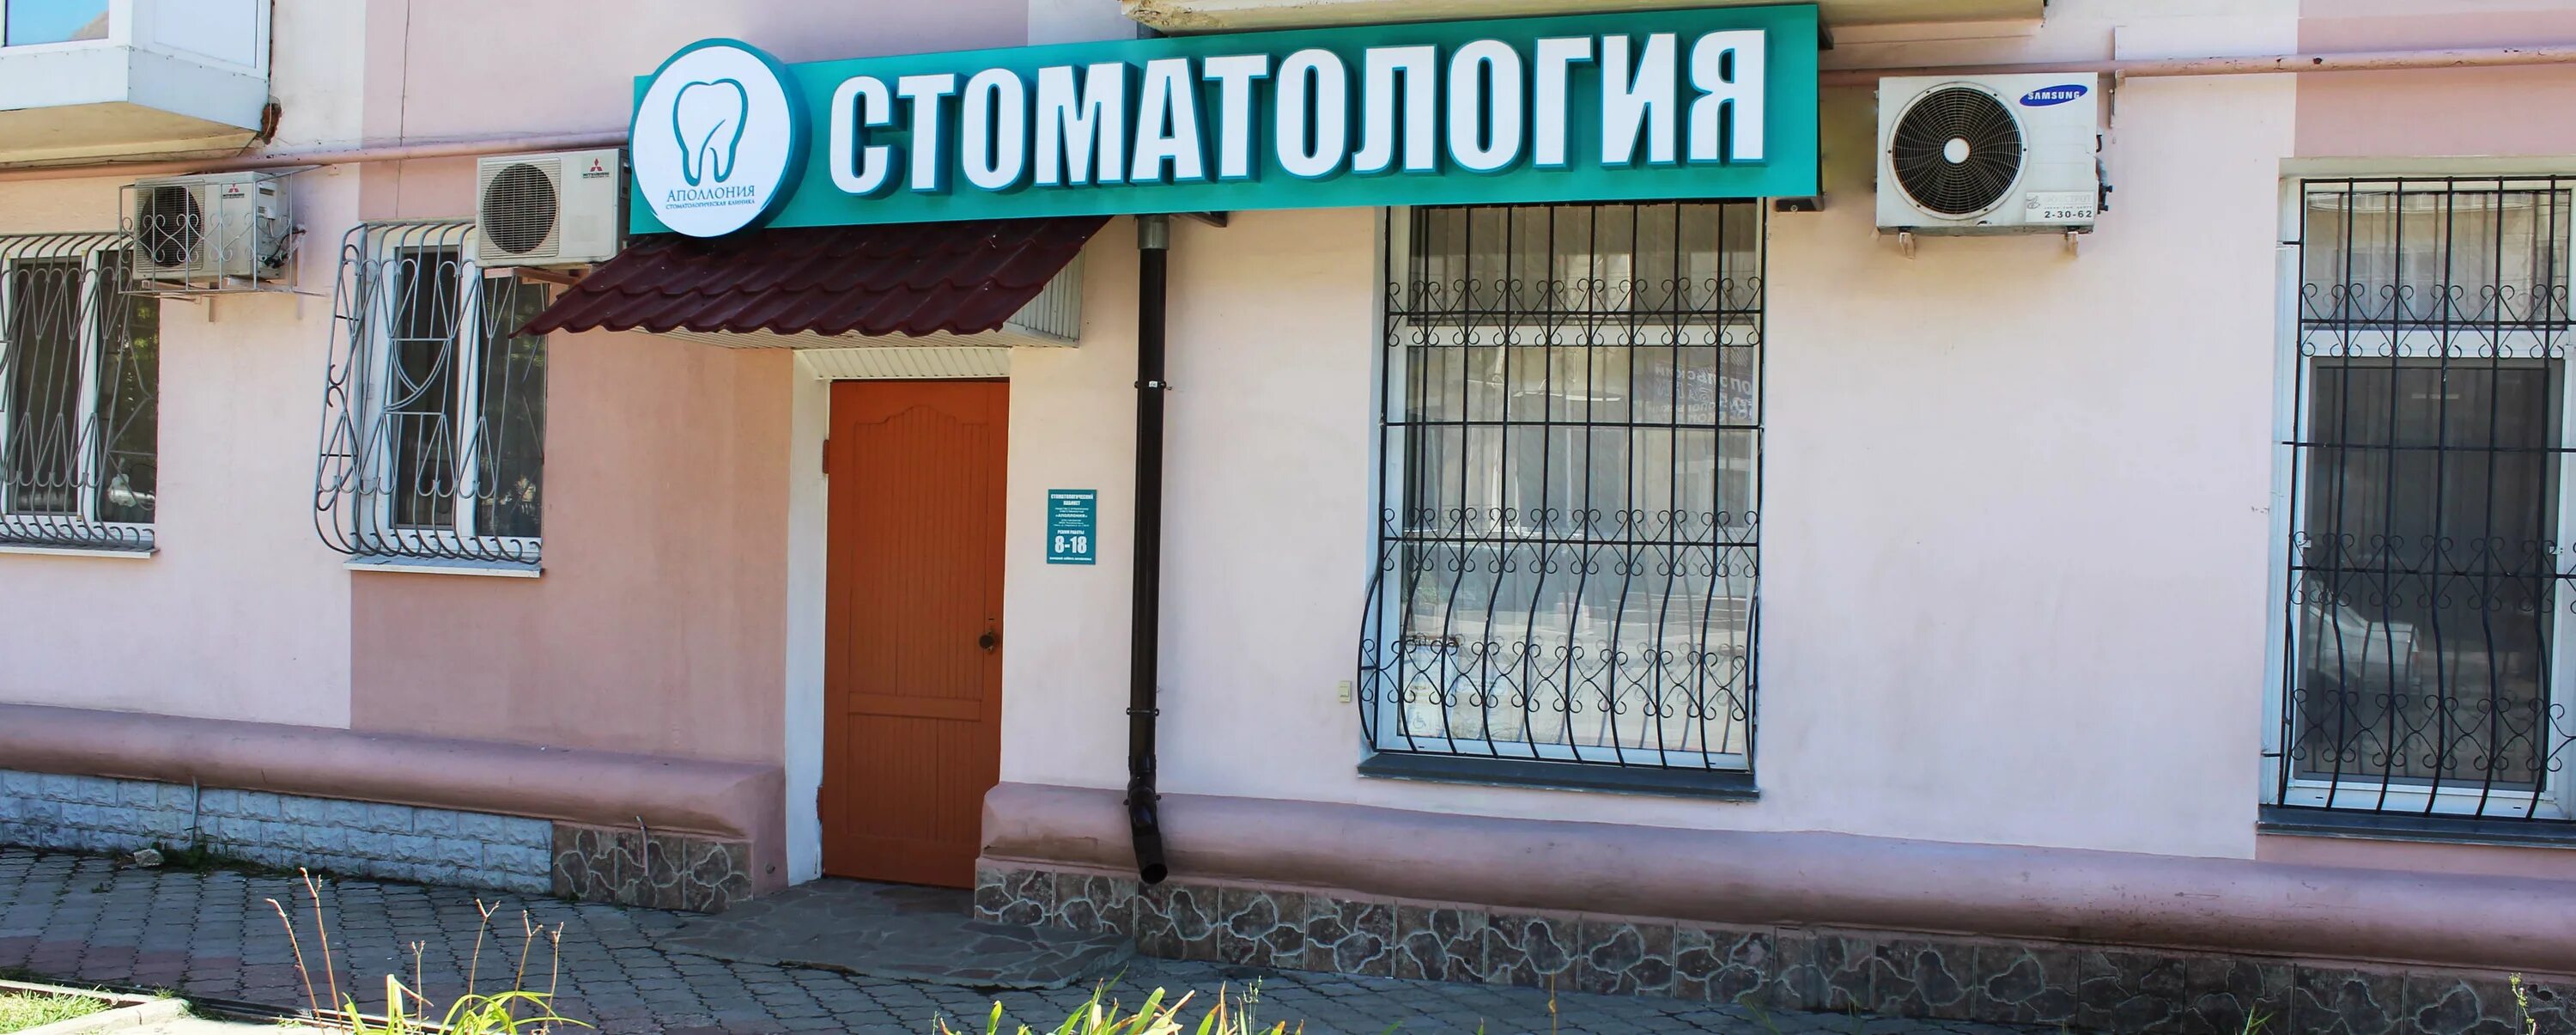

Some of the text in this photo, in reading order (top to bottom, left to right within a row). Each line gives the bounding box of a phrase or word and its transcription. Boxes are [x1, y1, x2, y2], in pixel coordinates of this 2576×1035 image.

[2027, 91, 2081, 100] SAMSUNG
[829, 28, 1769, 195] СТОМАТОЛОГИЯ
[666, 185, 756, 202] АПОЛЛОНИЯ
[665, 201, 726, 210] СТОМАТОЛОГИЧЕСКАЯ
[2044, 210, 2093, 219] 2-30-62
[1054, 536, 1087, 553] 8-18
